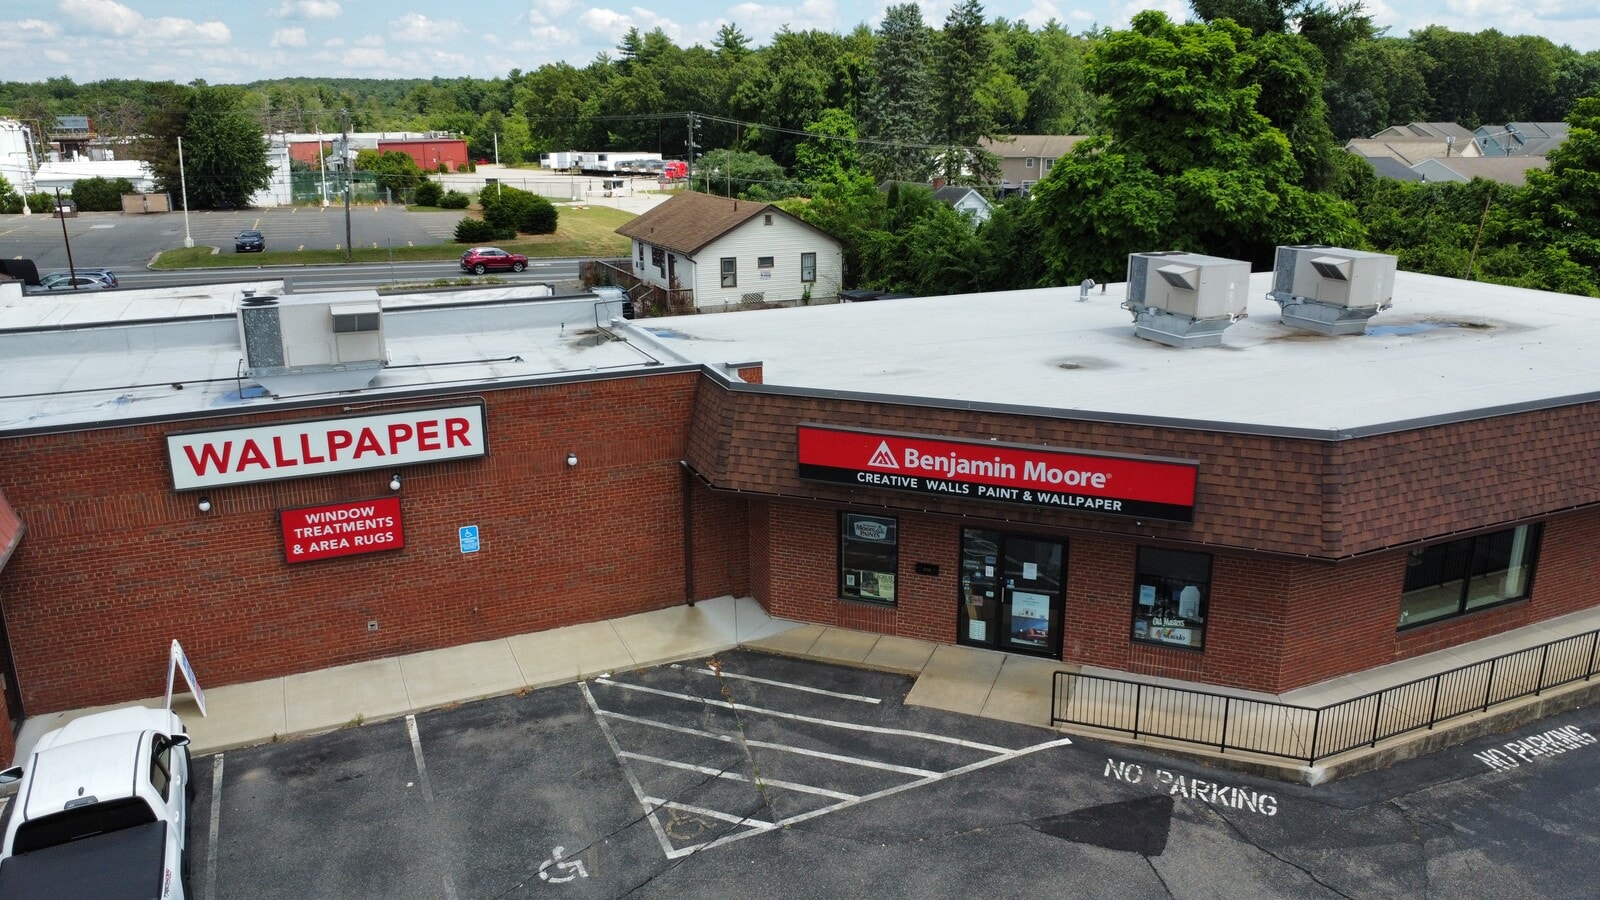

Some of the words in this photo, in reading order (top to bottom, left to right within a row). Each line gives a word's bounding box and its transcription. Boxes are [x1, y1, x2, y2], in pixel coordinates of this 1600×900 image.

[183, 417, 472, 477] WALLPAPER
[904, 448, 1016, 478] Benjamin
[857, 472, 918, 488] CREATIVE
[926, 479, 970, 494] WALLS
[978, 485, 1019, 500] PAINT
[1022, 490, 1033, 501] &
[1037, 492, 1122, 511] WALLPAPER
[294, 516, 394, 539] TREATMENTS
[305, 506, 375, 524] WINDOW
[293, 544, 304, 555] &
[309, 538, 350, 553] AREA
[354, 531, 394, 546] RUGS
[1473, 748, 1520, 772] NO
[1503, 725, 1597, 763] PARKING
[1104, 758, 1143, 783] NO
[1153, 769, 1278, 816] PARKING
